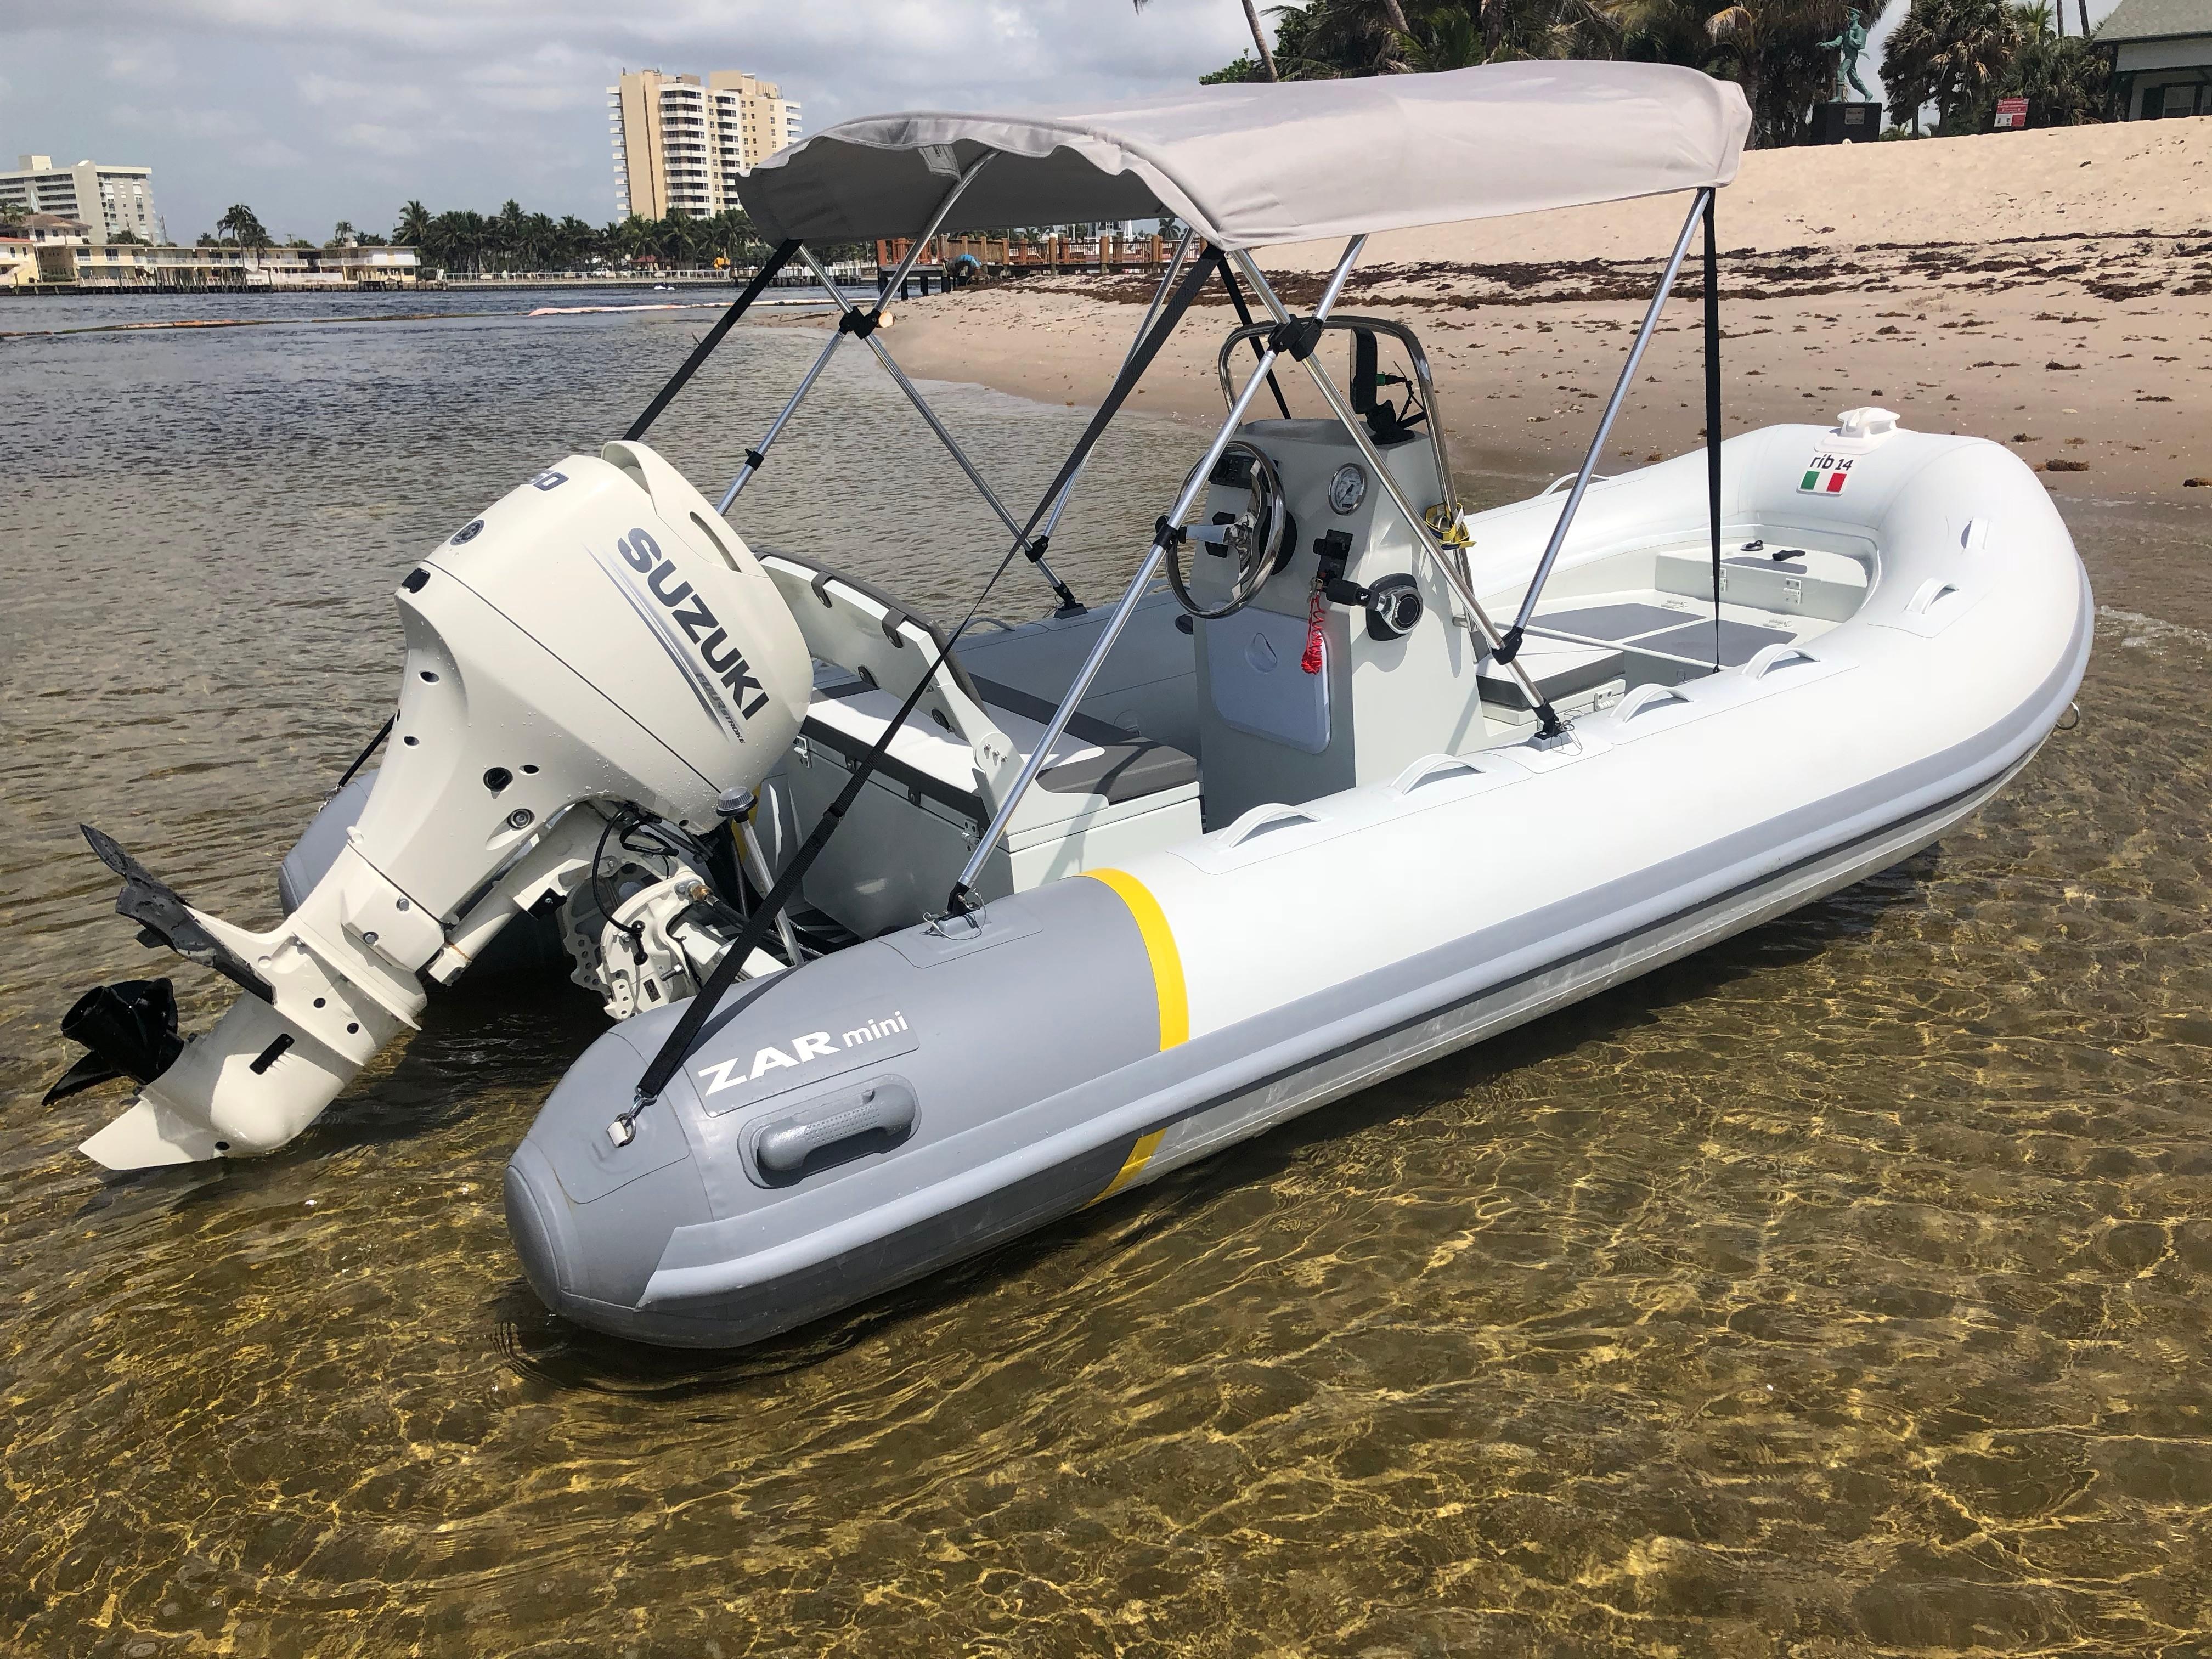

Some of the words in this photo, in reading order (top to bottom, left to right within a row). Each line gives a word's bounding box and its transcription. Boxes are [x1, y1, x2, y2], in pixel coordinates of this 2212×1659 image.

[1809, 454, 1835, 469] rib
[1835, 459, 1854, 471] 14
[617, 527, 770, 721] SUZUKI
[698, 1031, 842, 1097] ZAR
[842, 1010, 909, 1047] mini
